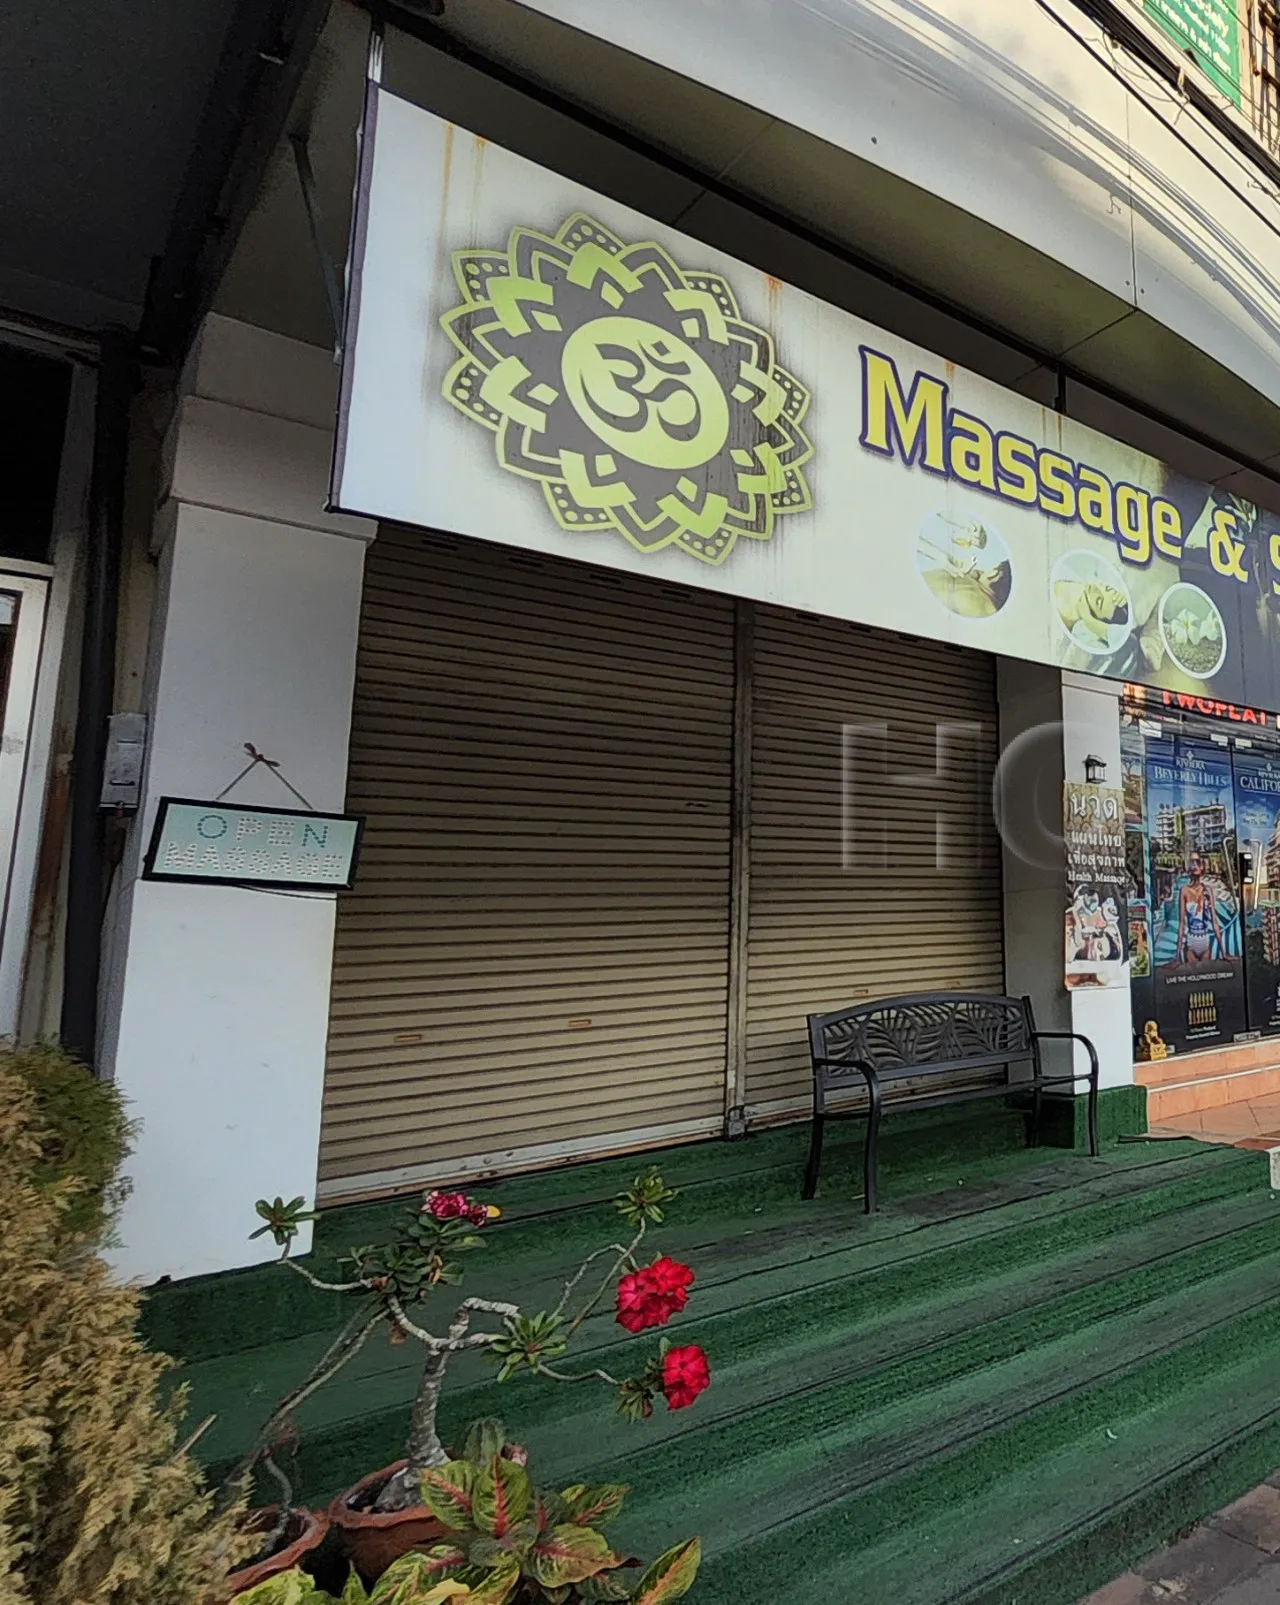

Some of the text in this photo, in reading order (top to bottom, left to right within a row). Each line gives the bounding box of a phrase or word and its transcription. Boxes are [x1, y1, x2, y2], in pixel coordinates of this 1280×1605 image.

[858, 345, 1184, 566] Massage
[1208, 507, 1249, 583] &
[1154, 766, 1228, 786] BEVERLY HILLS
[1070, 793, 1118, 820] นวด
[197, 814, 329, 849] OPEN
[164, 841, 344, 879] MASSAGE
[1068, 870, 1093, 882] Health
